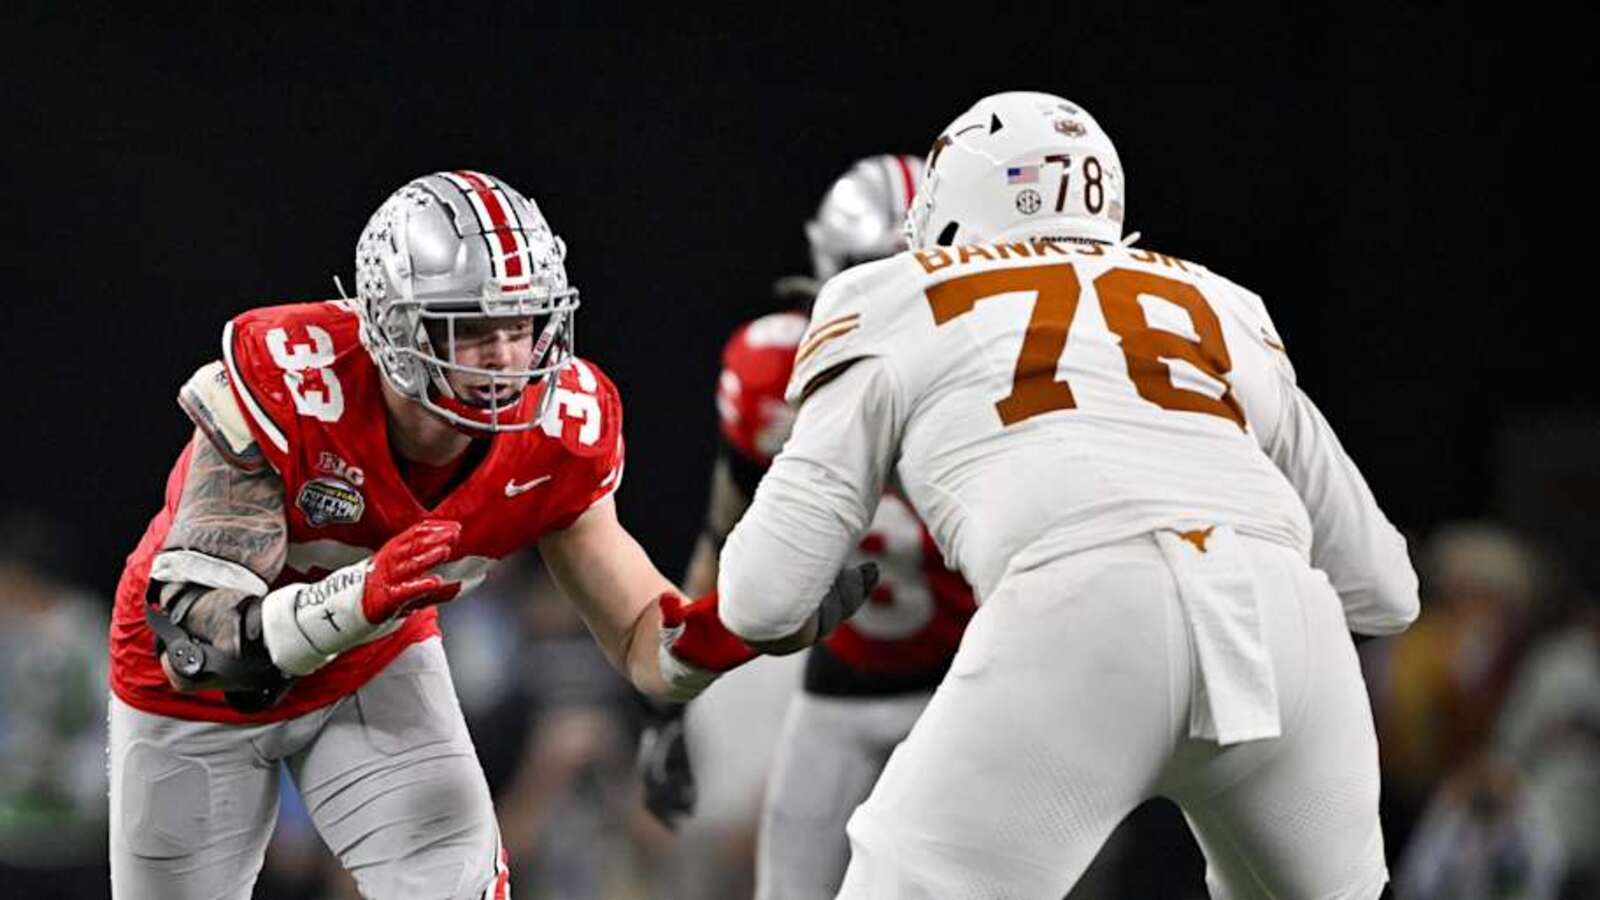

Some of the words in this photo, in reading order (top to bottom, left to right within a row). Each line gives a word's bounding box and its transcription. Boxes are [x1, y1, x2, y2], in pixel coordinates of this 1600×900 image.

[1045, 154, 1104, 215] 78
[265, 325, 345, 423] 33
[925, 262, 1247, 434] 78
